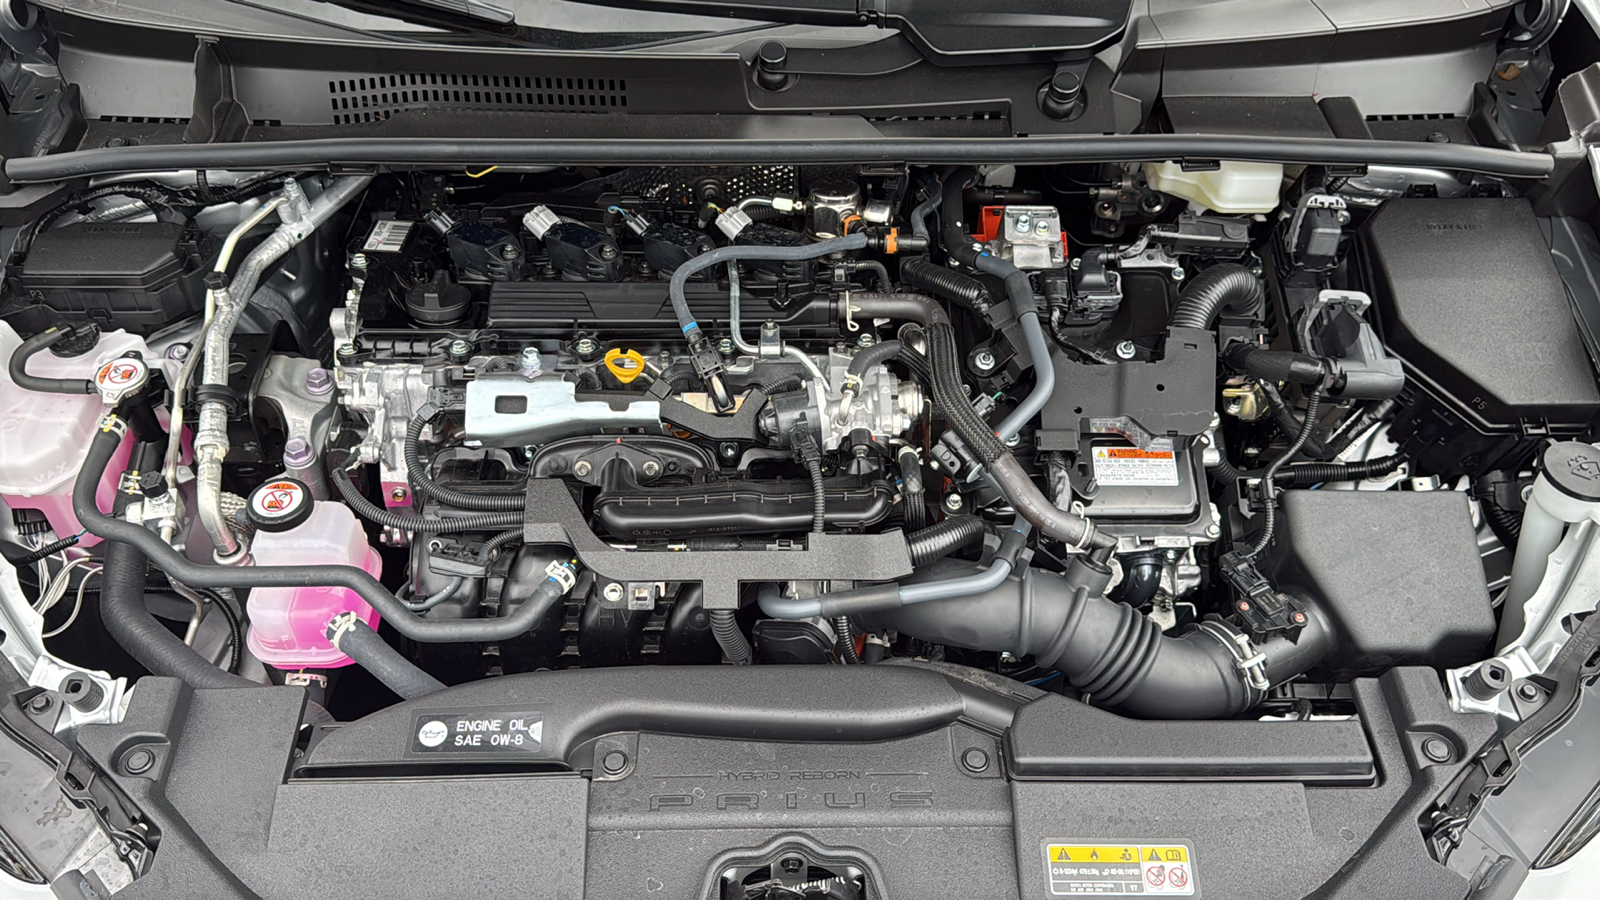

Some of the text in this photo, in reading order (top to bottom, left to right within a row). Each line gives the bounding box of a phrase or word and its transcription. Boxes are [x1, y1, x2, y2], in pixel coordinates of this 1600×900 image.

[29, 289, 45, 300] P3
[1471, 396, 1487, 410] P5
[456, 719, 529, 732] ENGINE OIL
[454, 734, 483, 746] SAE
[717, 770, 861, 781] HYBRID REBORN
[648, 791, 934, 811] PRIUS
